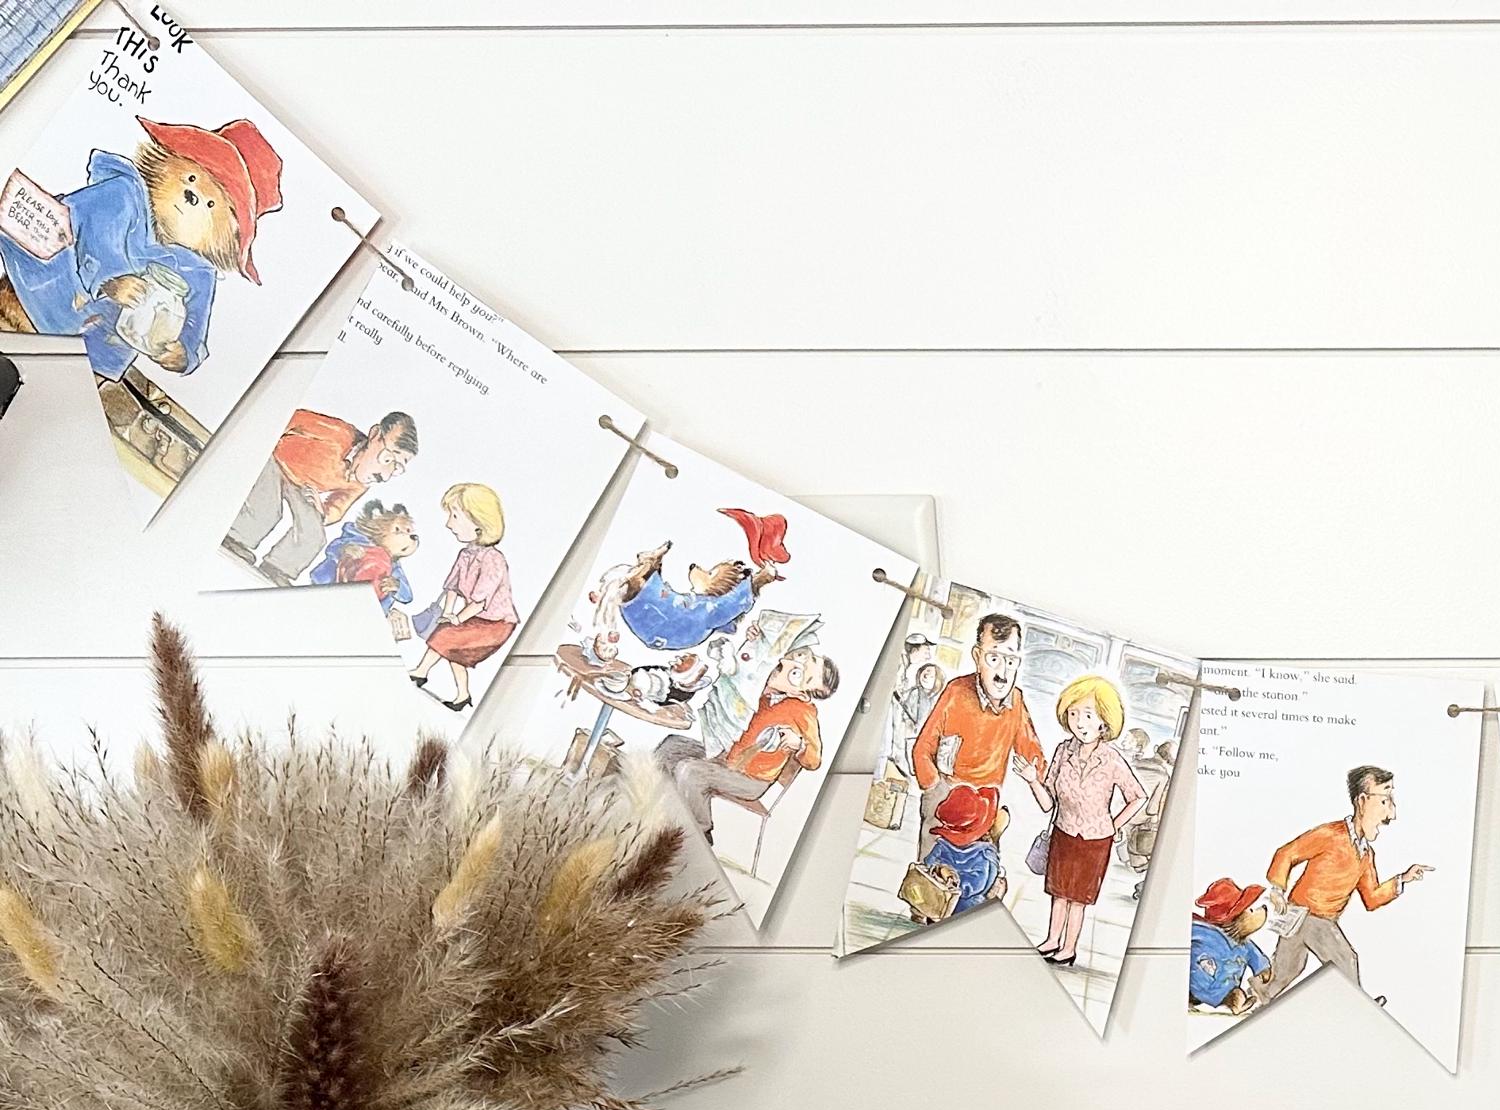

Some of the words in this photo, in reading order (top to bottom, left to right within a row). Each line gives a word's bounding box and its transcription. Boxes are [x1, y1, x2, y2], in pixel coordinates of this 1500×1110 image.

[116, 27, 158, 73] THIS
[88, 70, 122, 106] you.
[101, 50, 152, 104] Thank
[15, 187, 45, 212] PLEASE
[8, 206, 31, 229] BEAR
[405, 255, 419, 269] we
[420, 268, 449, 290] could
[449, 284, 471, 306] help
[354, 321, 383, 345] really
[428, 296, 448, 315] Mrs
[450, 311, 485, 342] Brown.
[530, 369, 548, 384] are
[371, 308, 413, 342] carefully
[415, 335, 446, 363] before
[447, 361, 489, 395] replying.
[1313, 672, 1330, 683] she
[1333, 674, 1357, 685] said.
[1242, 687, 1259, 698] the
[1231, 707, 1238, 717] it
[1241, 710, 1278, 720] several
[1281, 712, 1309, 722] times
[1313, 715, 1323, 723] to
[1327, 714, 1357, 726] make
[1219, 769, 1240, 779] you
